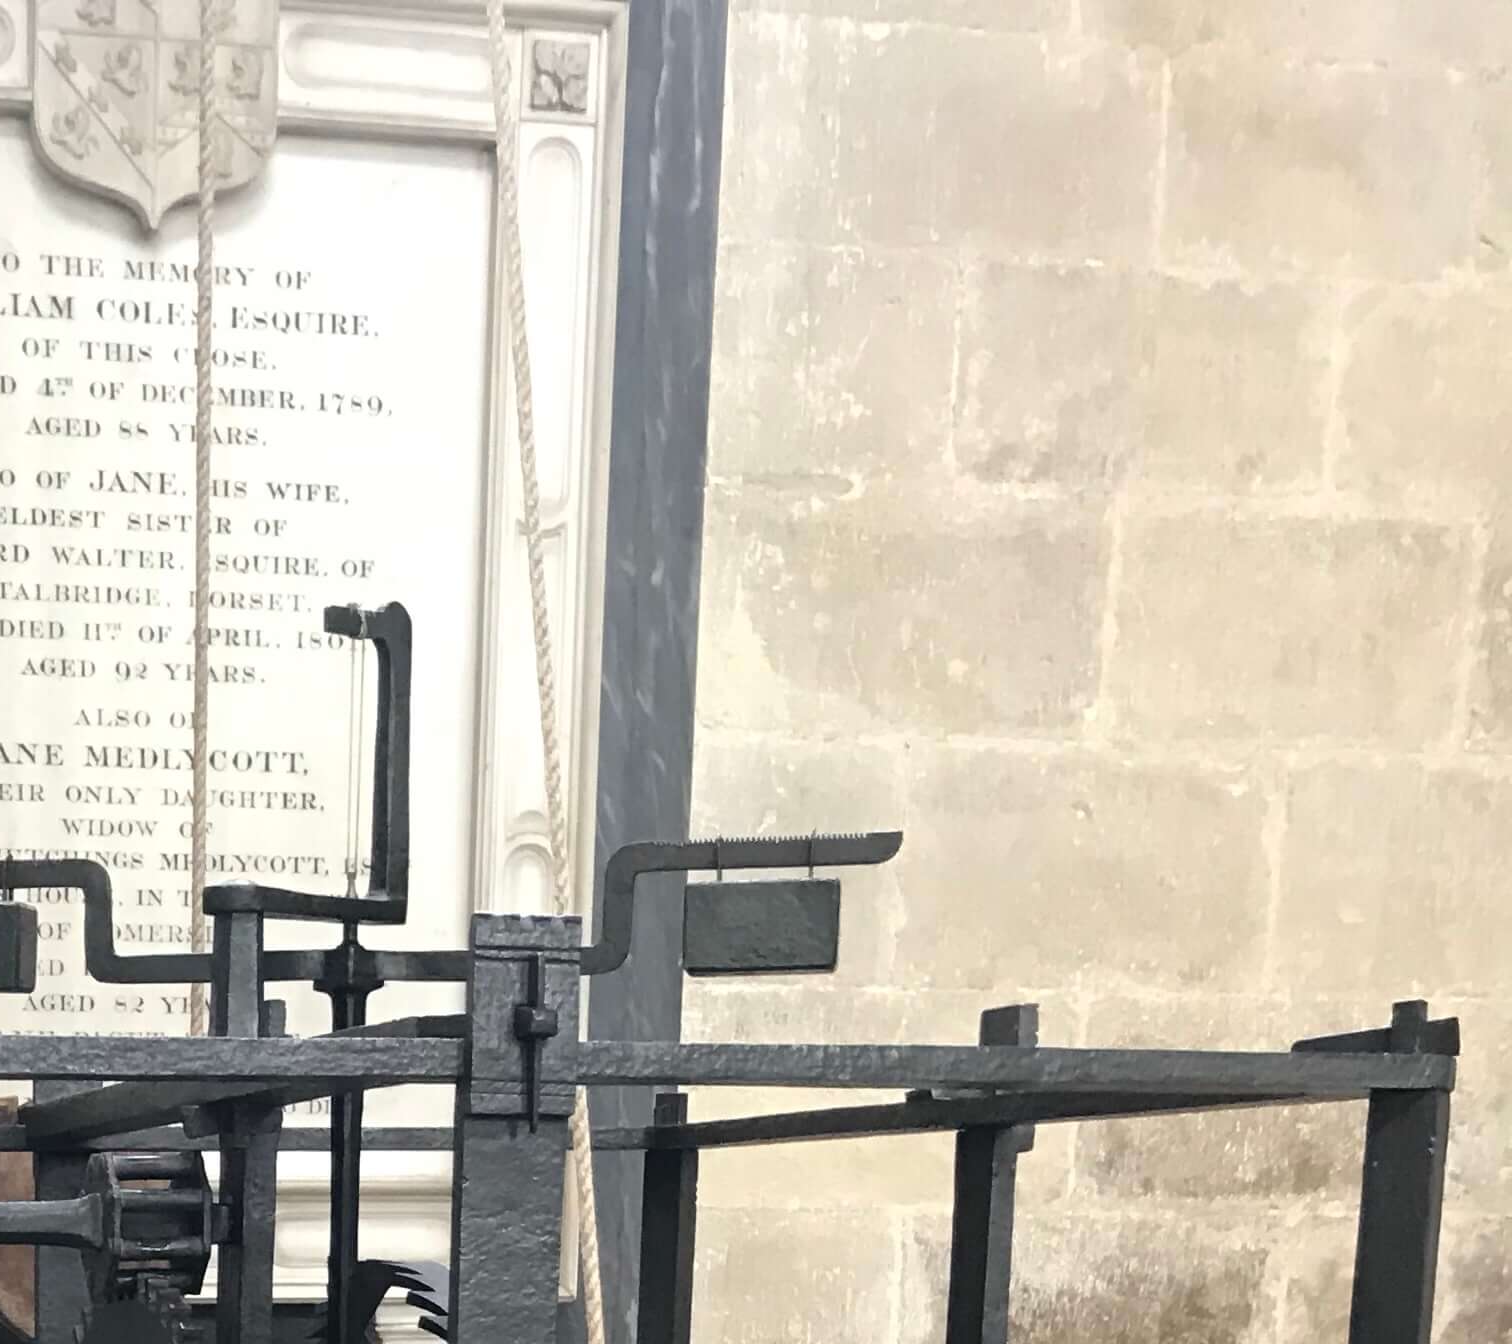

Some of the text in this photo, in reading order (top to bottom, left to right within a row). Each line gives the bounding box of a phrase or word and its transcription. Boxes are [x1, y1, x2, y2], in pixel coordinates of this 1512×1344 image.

[40, 254, 104, 278] THE
[123, 260, 254, 286] MEMRY
[275, 271, 311, 290] OF
[96, 299, 218, 328] COLE,
[21, 338, 59, 359] OF
[79, 341, 153, 363] THIS
[89, 381, 124, 401] OF
[141, 383, 306, 411] DECMBER,
[25, 416, 102, 438] AGED
[119, 420, 149, 439] 88
[36, 470, 71, 490] OF
[209, 479, 248, 499] HIS
[266, 482, 350, 505] WIFE,
[127, 513, 232, 536] SISTR
[254, 519, 288, 537] OF
[213, 553, 328, 578] SQUIRE,
[341, 559, 375, 579] OF
[138, 625, 172, 644] OF
[297, 631, 356, 651] 180
[21, 658, 96, 678] AGED
[115, 661, 148, 683] 92
[73, 708, 151, 728] ALSO
[65, 785, 141, 806] ONLY
[61, 818, 158, 838] WIDOW
[345, 857, 373, 876] ES
[138, 889, 163, 906] IN
[37, 922, 71, 939] OF
[23, 995, 95, 1012] AGED
[115, 996, 145, 1014] 82
